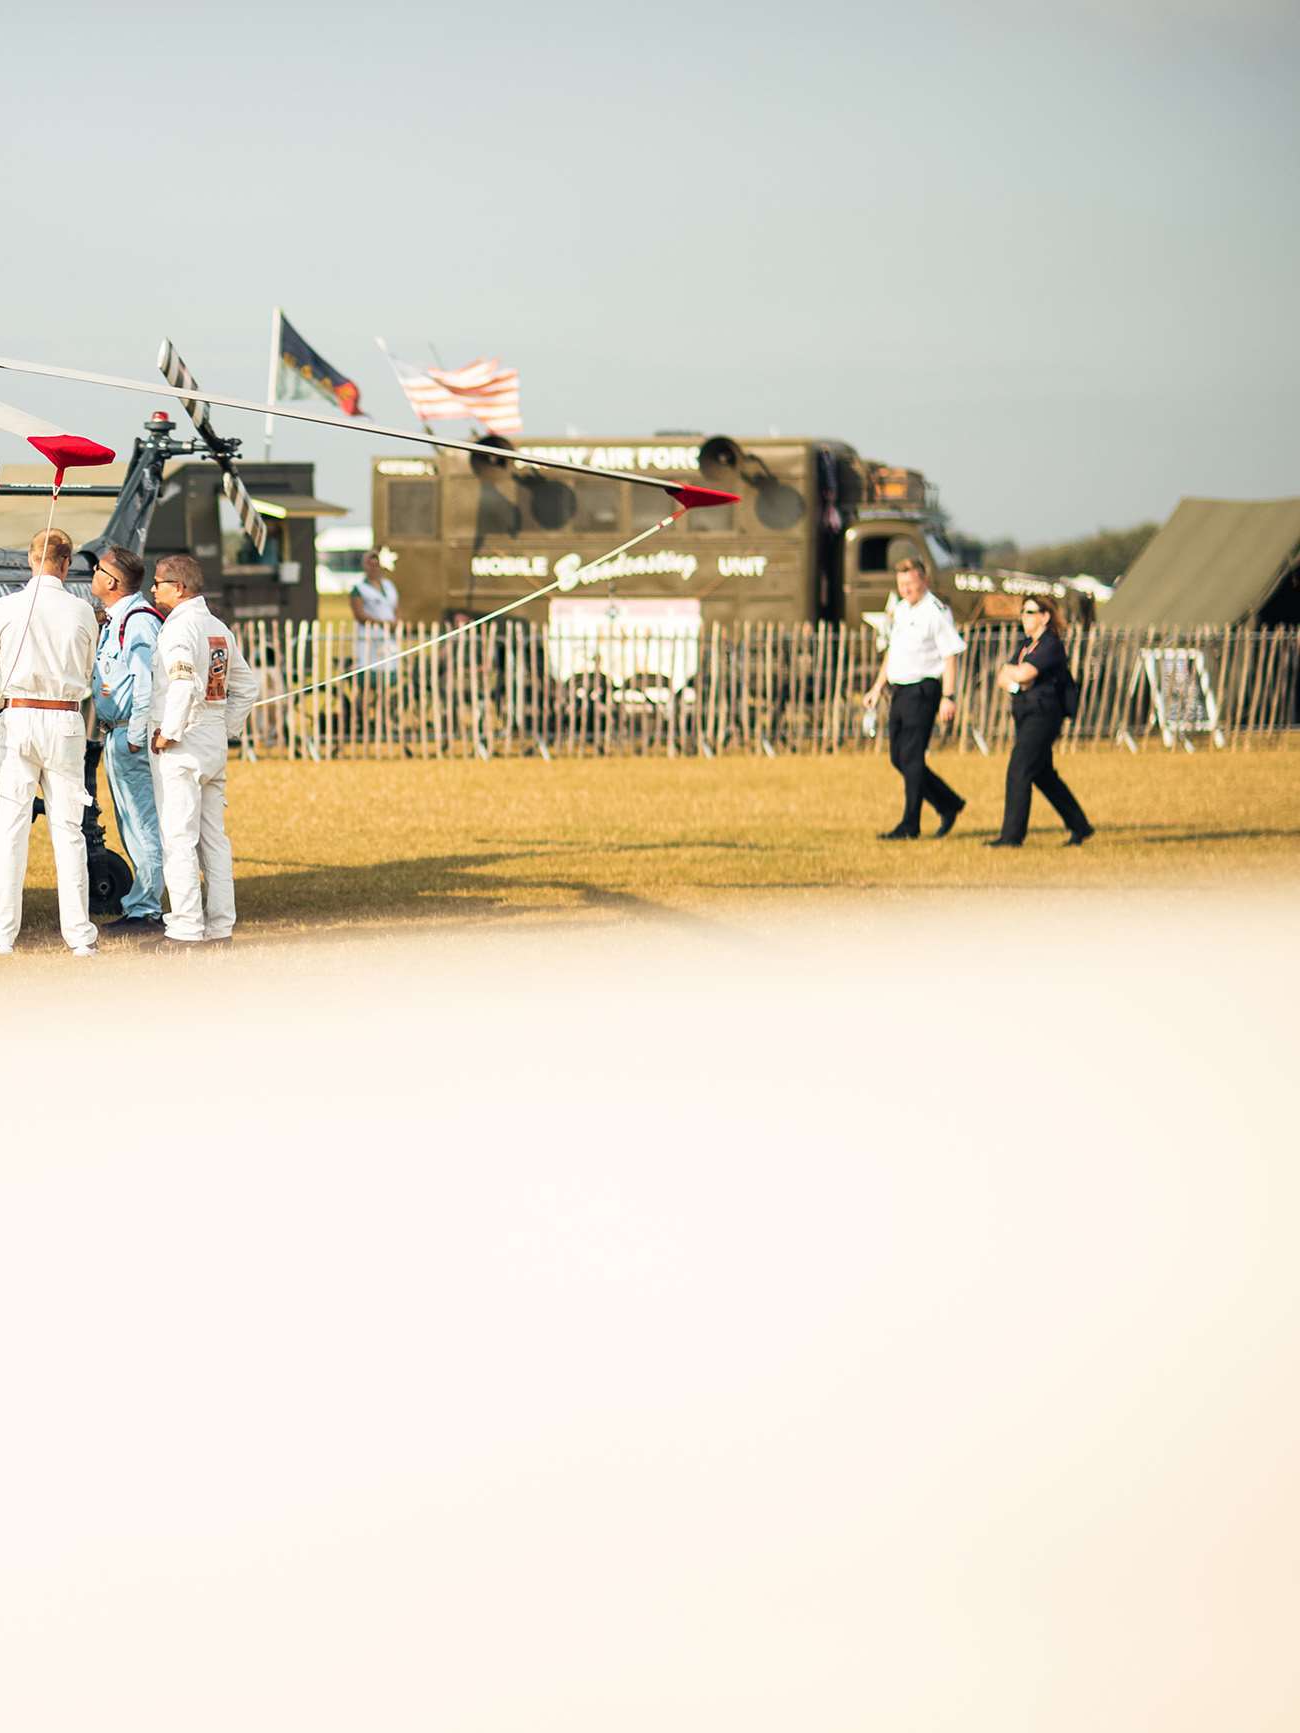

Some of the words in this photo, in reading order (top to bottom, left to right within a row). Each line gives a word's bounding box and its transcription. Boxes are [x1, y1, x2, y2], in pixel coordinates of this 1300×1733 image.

[589, 446, 636, 470] AIR
[638, 446, 701, 470] FORC
[471, 556, 549, 577] MOBILE
[717, 555, 768, 577] UNIT
